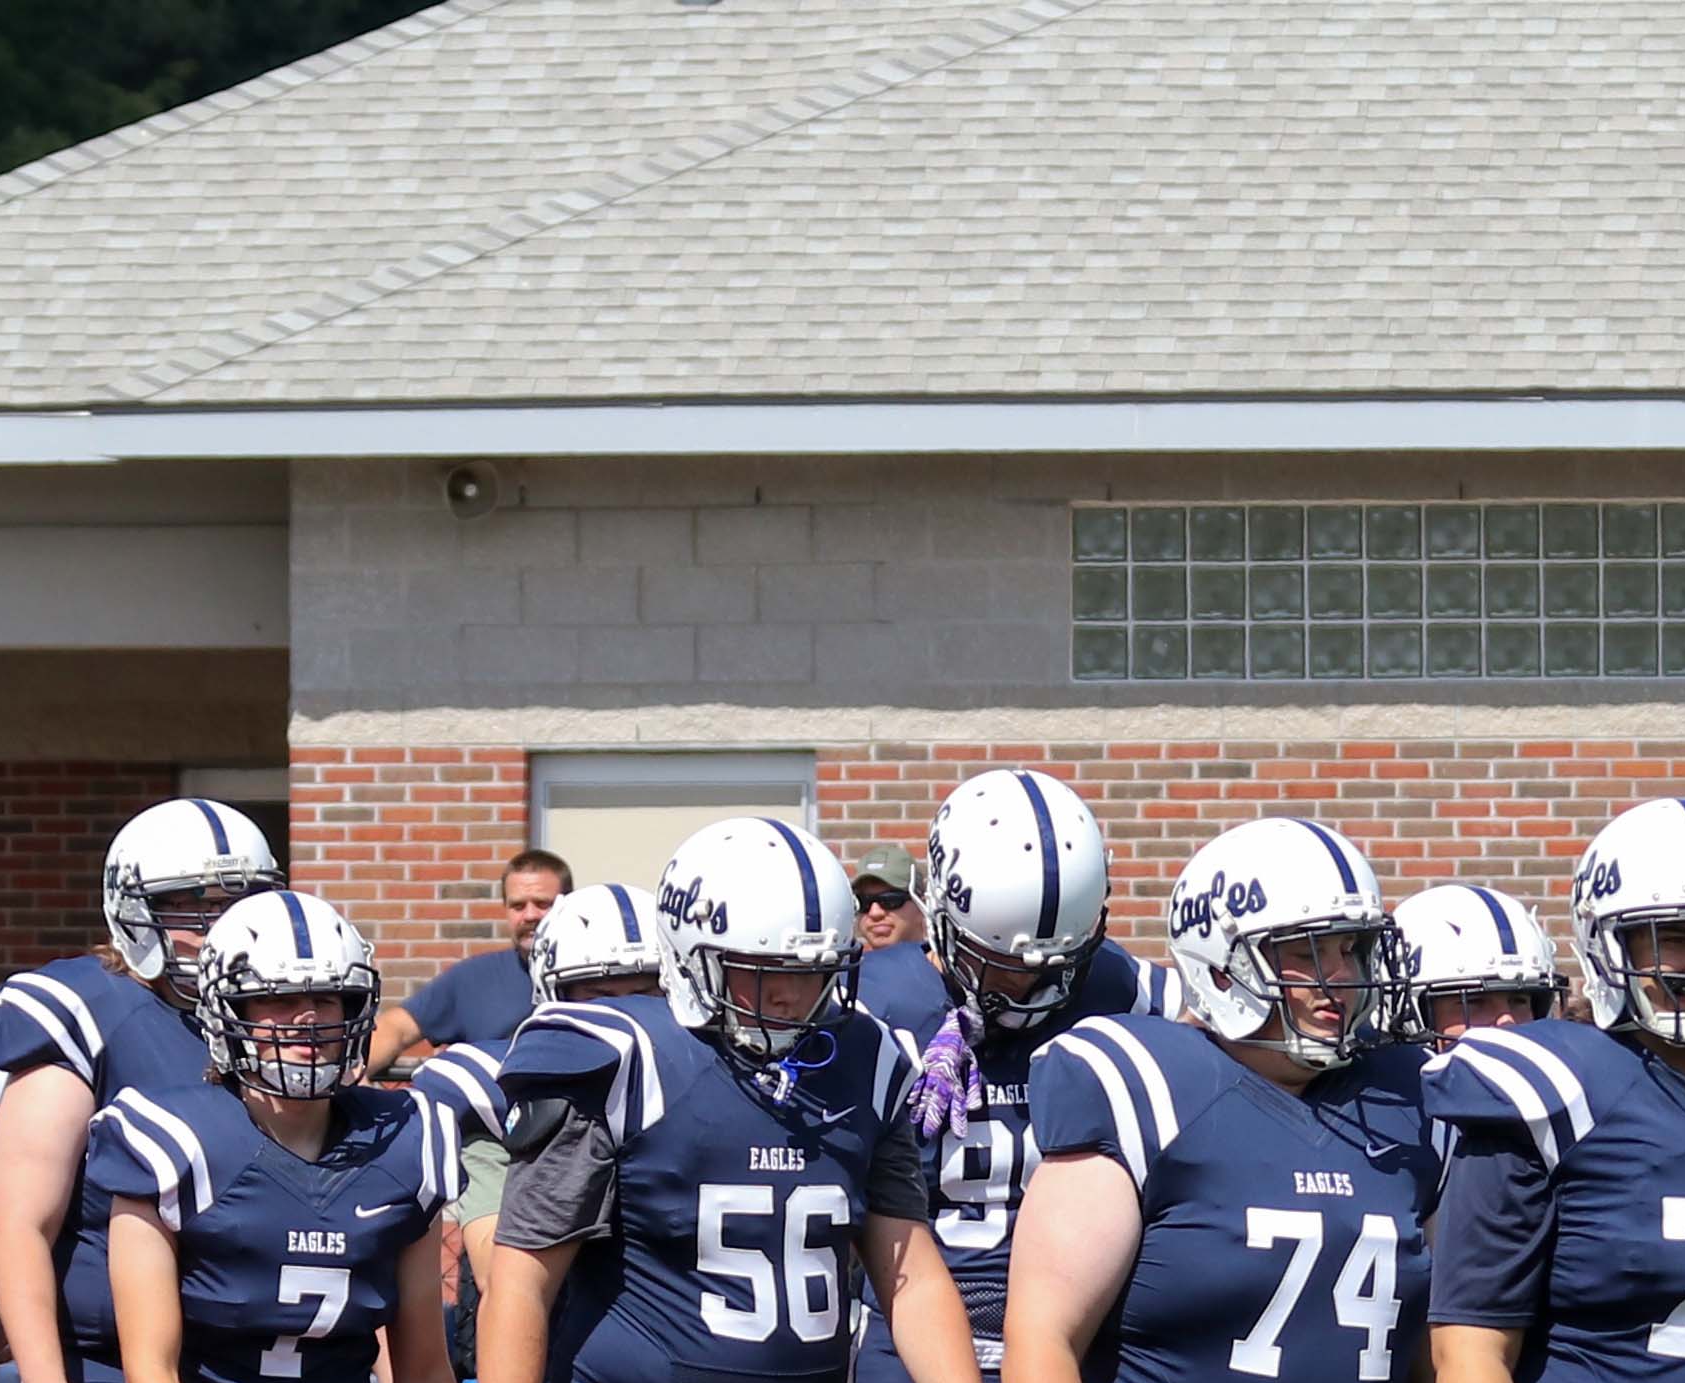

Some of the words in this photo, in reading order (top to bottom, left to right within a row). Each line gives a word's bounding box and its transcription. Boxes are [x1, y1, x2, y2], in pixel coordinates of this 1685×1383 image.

[748, 1145, 806, 1173] EAGLES
[934, 1119, 1044, 1250] 9
[1293, 1170, 1355, 1198] EAGLES
[286, 1229, 347, 1256] EAGLES
[695, 1182, 855, 1344] 56
[1227, 1205, 1403, 1383] 74
[259, 1263, 352, 1379] 7
